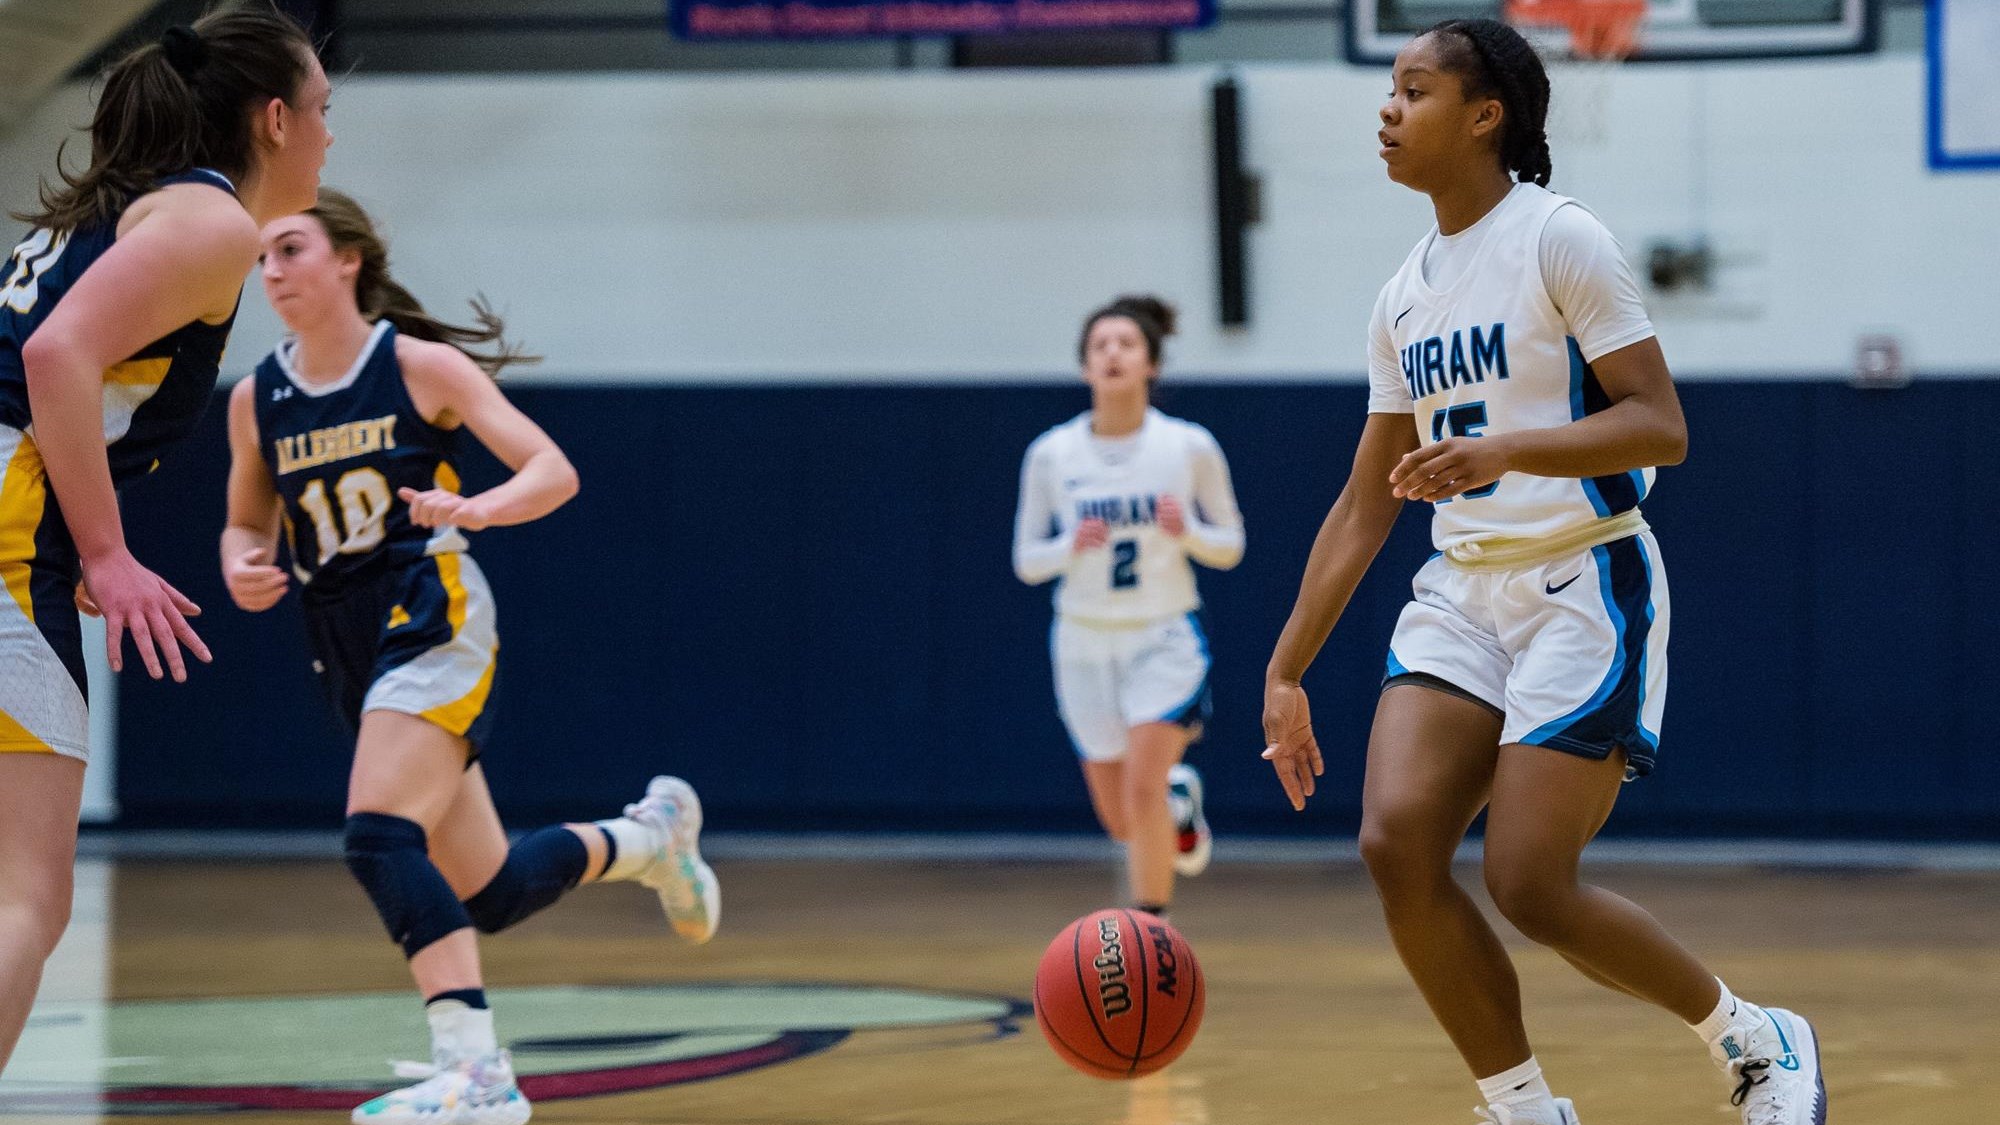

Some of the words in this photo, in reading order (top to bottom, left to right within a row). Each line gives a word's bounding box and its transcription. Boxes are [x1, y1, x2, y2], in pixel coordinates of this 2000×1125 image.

[1401, 322, 1510, 401] HIRAM
[298, 466, 393, 567] 10
[1111, 539, 1140, 589] 2
[1093, 917, 1132, 1020] Wilson
[1148, 924, 1177, 998] NCAA
